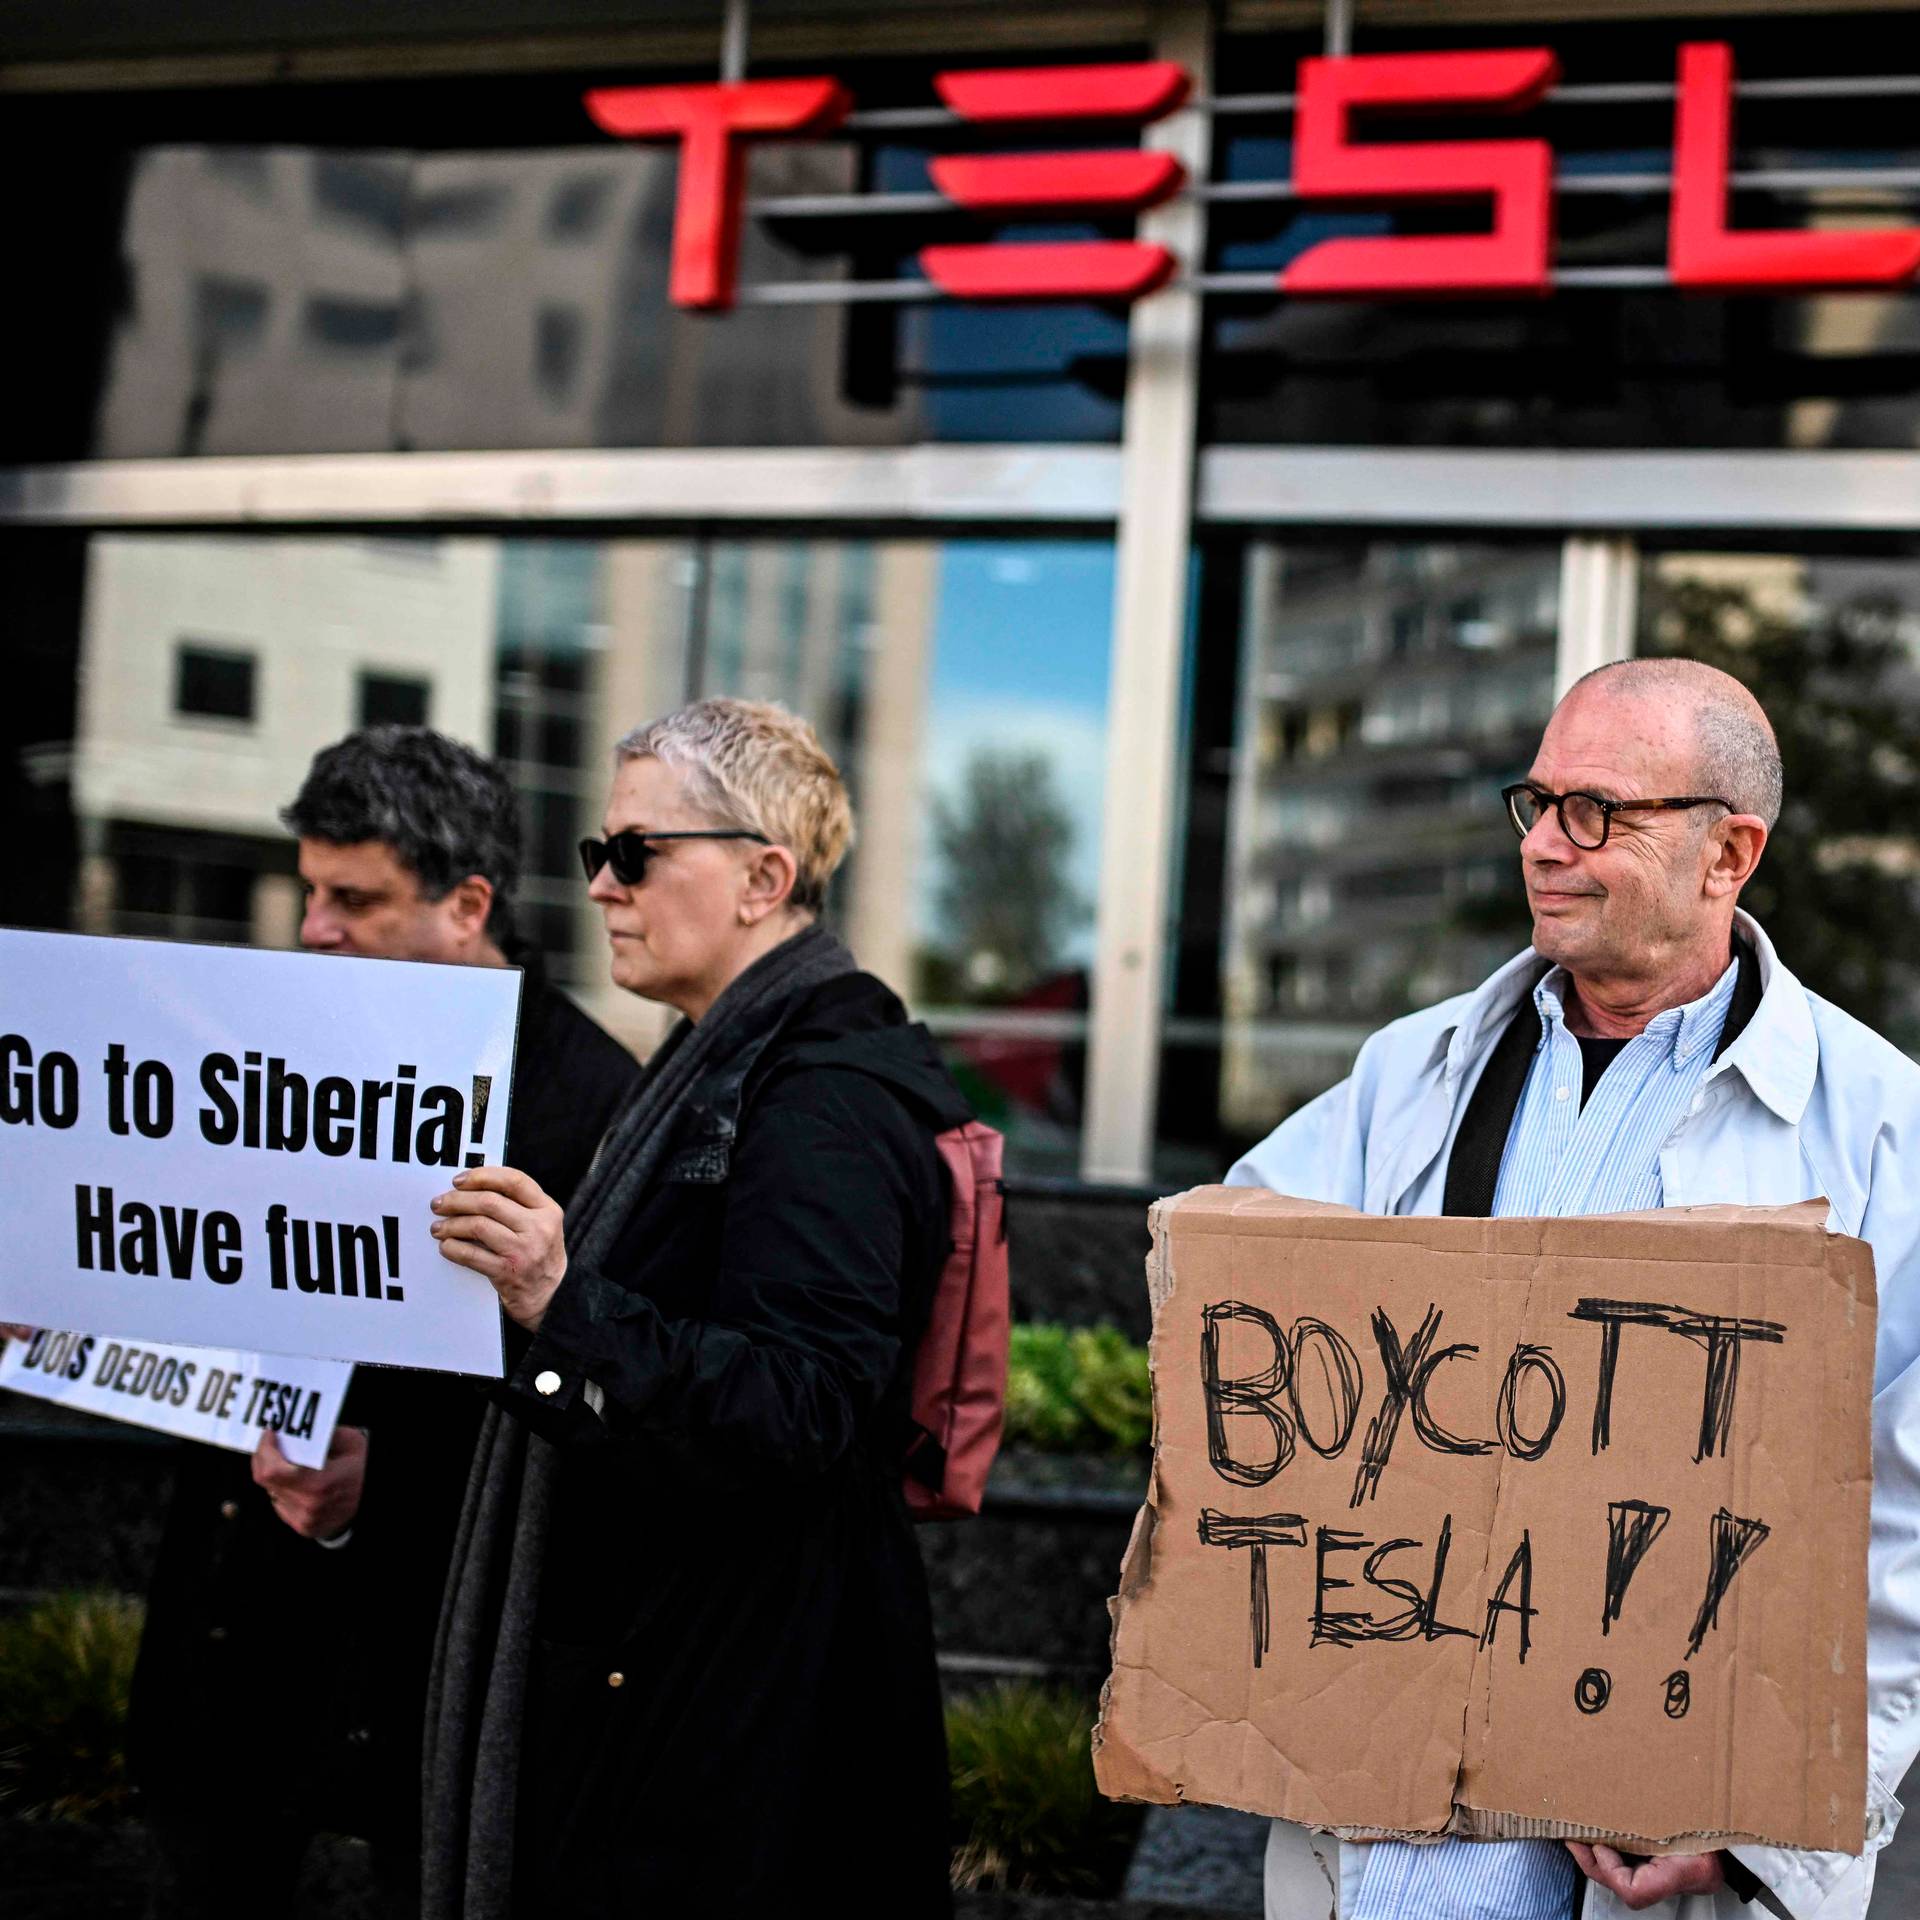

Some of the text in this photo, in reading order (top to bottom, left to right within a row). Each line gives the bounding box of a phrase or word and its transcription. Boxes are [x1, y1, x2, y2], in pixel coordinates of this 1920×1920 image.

[0, 1034, 493, 1168] Go to Siberia!
[75, 1183, 404, 1302] Have fun!
[21, 1329, 321, 1440] DOIS DEDOS DE TESLA
[1200, 1299, 1788, 1508] BOYCOTT
